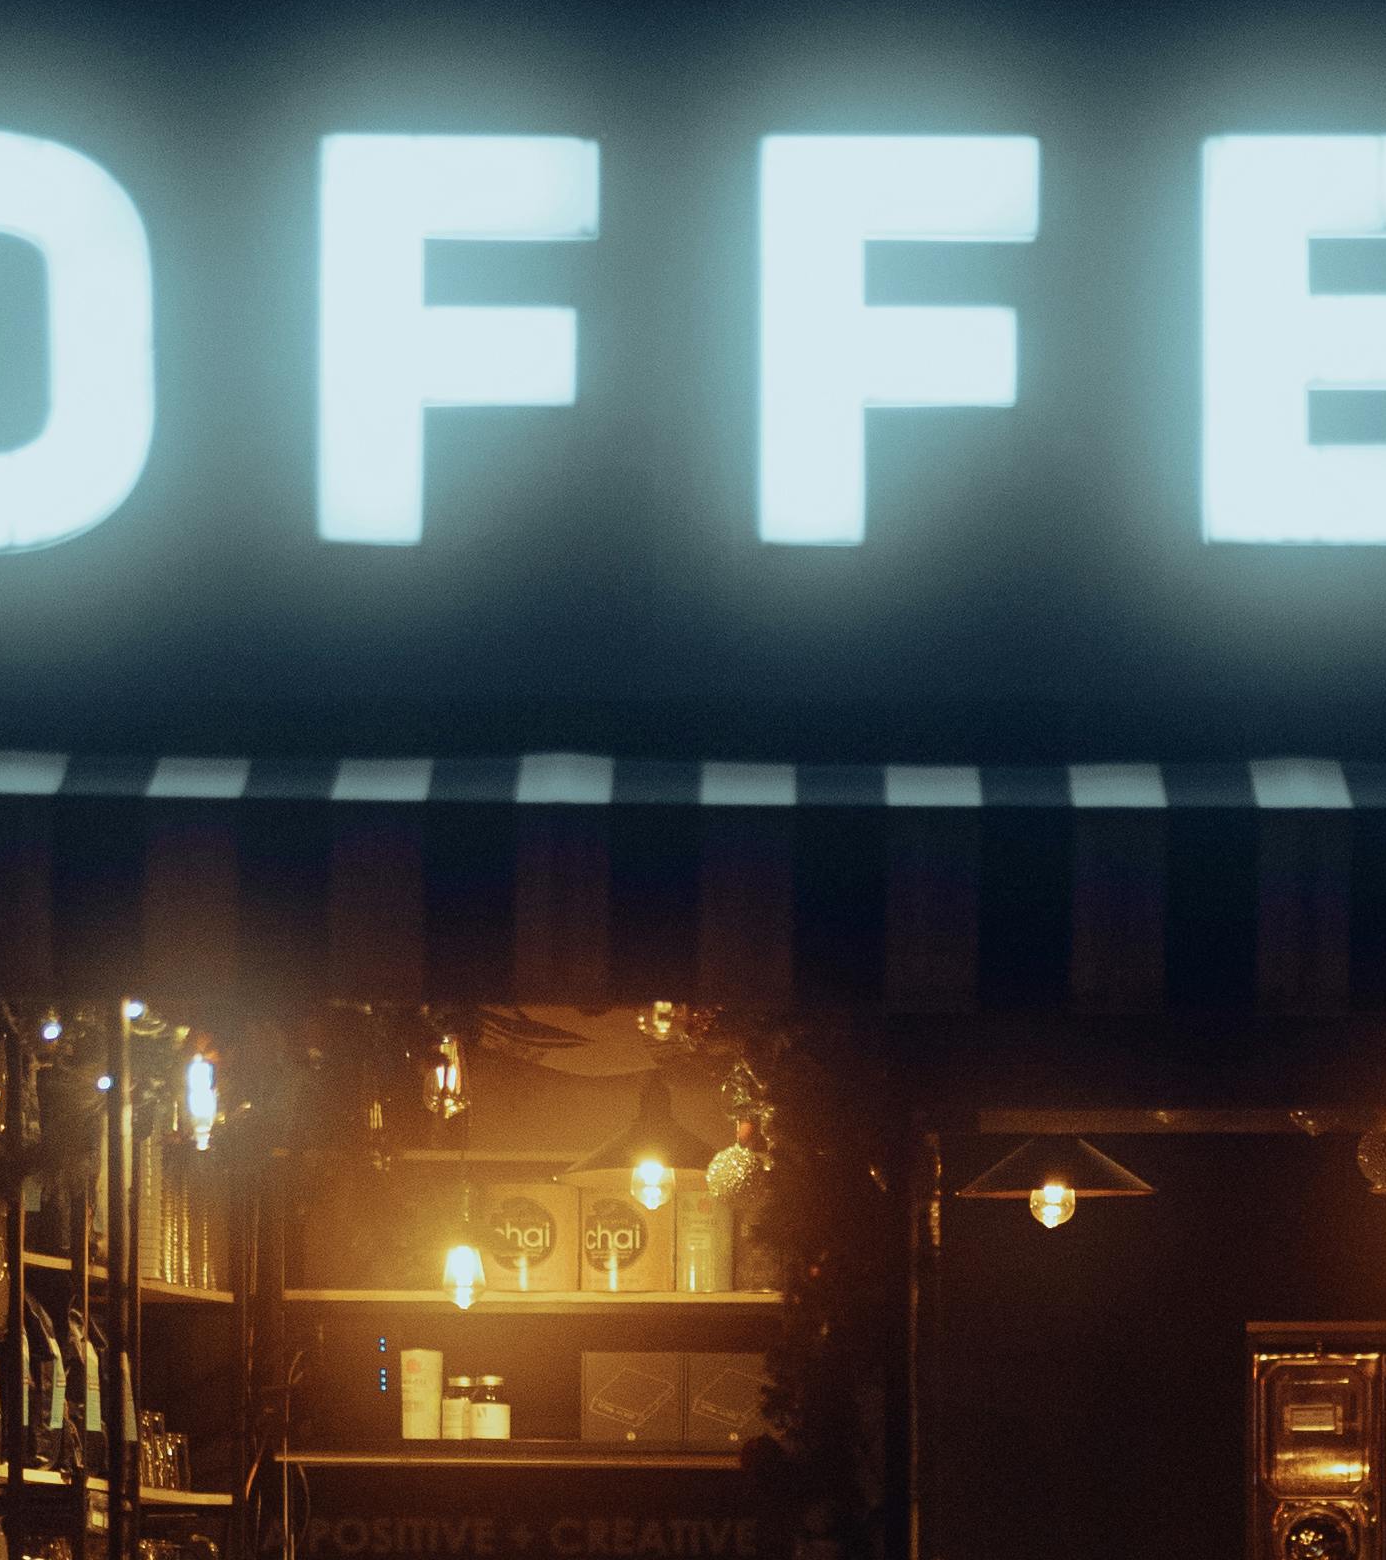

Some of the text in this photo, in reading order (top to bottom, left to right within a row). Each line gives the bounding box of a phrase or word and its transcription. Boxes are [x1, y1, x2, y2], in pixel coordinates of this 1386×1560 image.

[586, 1223, 641, 1250] chai
[308, 1516, 497, 1555] POSITIVE
[547, 1516, 759, 1556] CREATIVE
